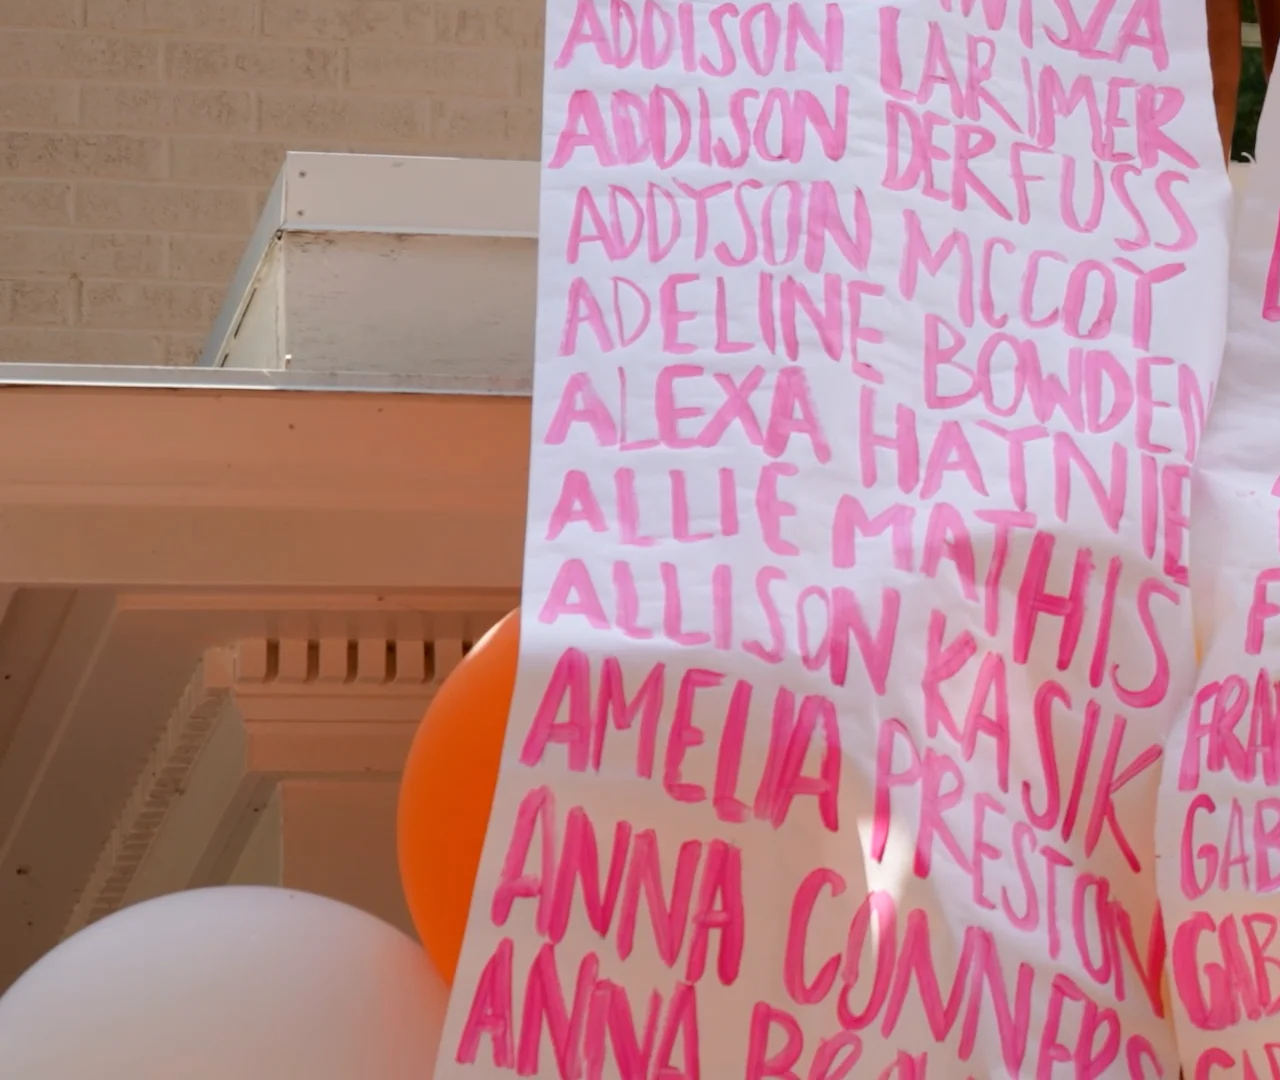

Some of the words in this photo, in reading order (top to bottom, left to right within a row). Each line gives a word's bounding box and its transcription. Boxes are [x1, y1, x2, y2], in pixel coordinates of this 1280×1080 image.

[548, 84, 849, 169] ADDISON
[881, 100, 1198, 251] DERFUSS
[878, 7, 1199, 168] LARIMER
[566, 178, 872, 273] ADDYSON
[898, 208, 1186, 351] MCCOY
[544, 363, 832, 464] ALEXA
[558, 273, 886, 383] ADELINE
[922, 311, 1214, 463] BOWDEN
[545, 462, 799, 556] ALLIE
[831, 493, 1181, 708] MATHIS
[538, 557, 901, 695] ALLISON
[922, 608, 1163, 873] KASIK
[490, 784, 745, 985] ANNA
[518, 645, 840, 832] AMELIA
[870, 718, 1166, 1019] PRESTON
[455, 936, 700, 1080] ANNA
